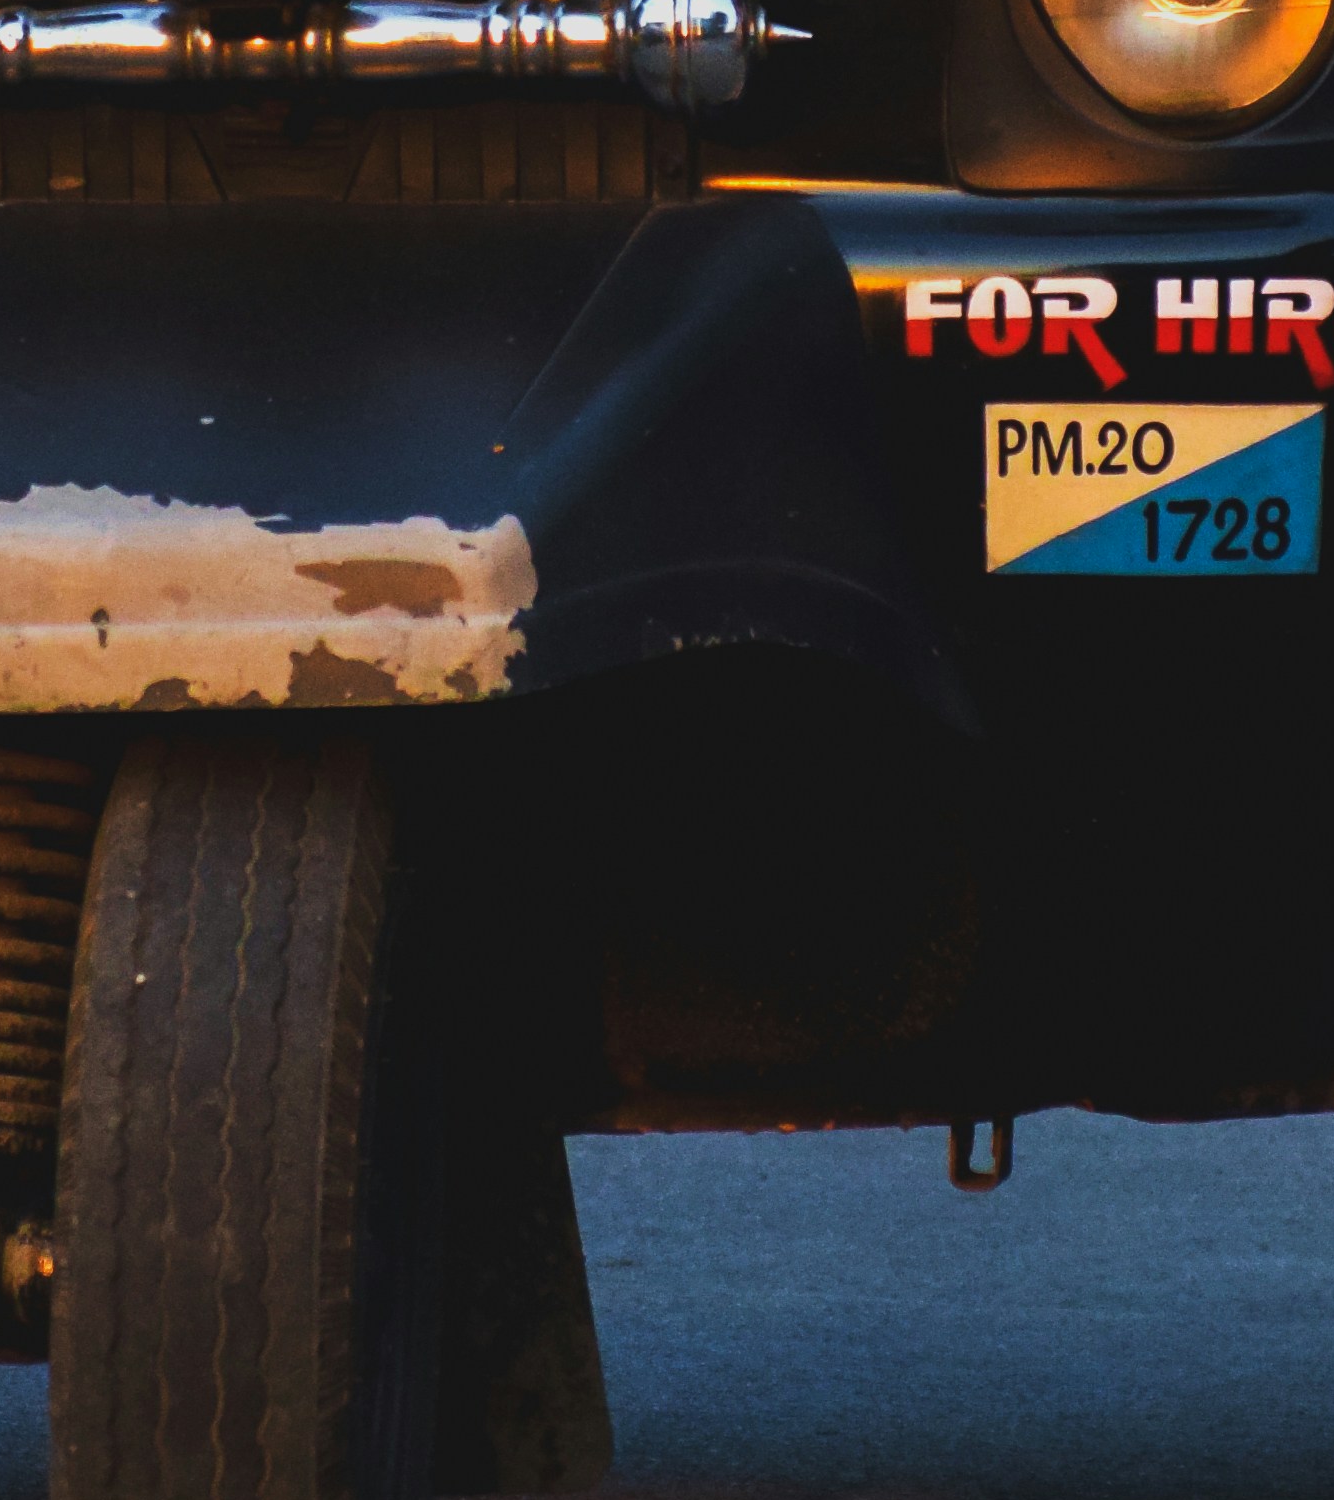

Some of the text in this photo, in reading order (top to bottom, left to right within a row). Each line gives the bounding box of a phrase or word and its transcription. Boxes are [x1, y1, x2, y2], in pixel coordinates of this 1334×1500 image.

[905, 275, 1128, 392] FOR
[998, 418, 1175, 478] PM.20
[1142, 498, 1292, 563] 1728
